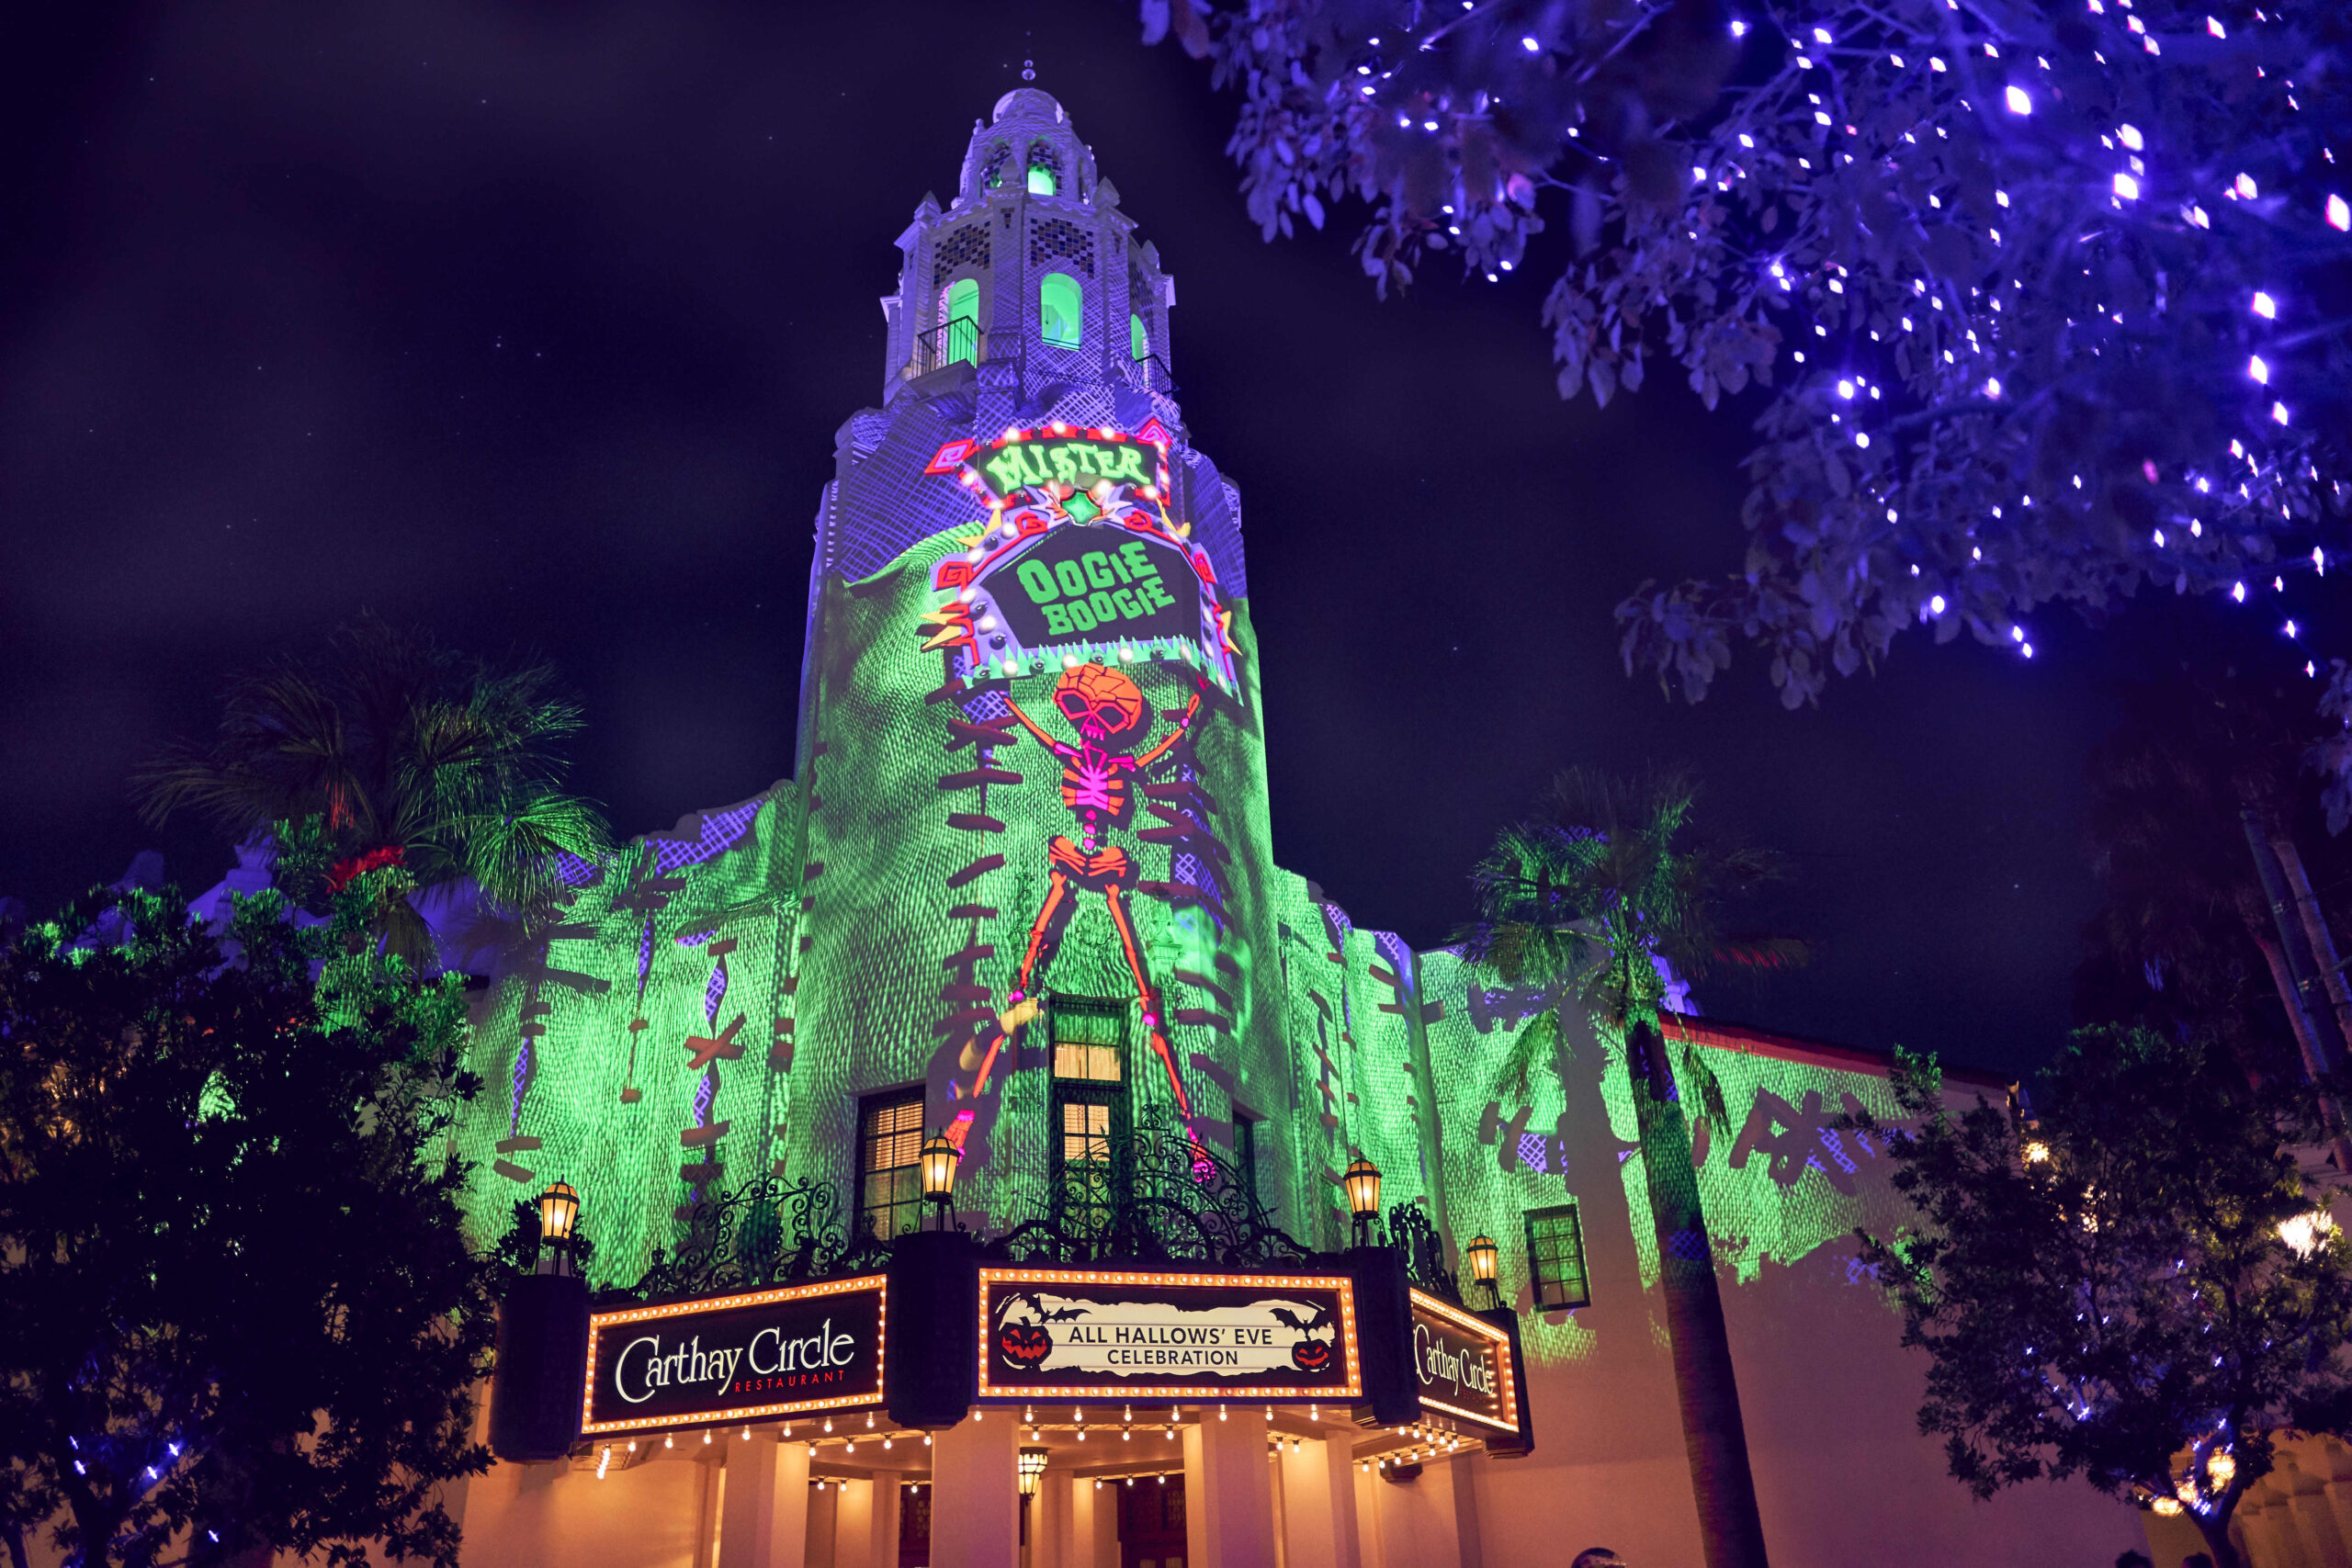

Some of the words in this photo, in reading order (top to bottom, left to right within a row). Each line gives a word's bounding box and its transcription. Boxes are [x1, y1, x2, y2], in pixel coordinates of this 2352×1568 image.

[987, 444, 1150, 493] MISTER
[1016, 541, 1158, 604] OOGIE
[1040, 576, 1176, 636] BOOGIE
[616, 1335, 743, 1404] Carthay
[749, 1318, 854, 1374] Circle
[1069, 1326, 1108, 1344] ALL
[1115, 1327, 1226, 1345] HALLOWS'
[1234, 1328, 1272, 1345] EVE
[1107, 1348, 1238, 1366] CELEBRATION
[1414, 1324, 1459, 1396] Carthay
[1460, 1348, 1493, 1394] Circle
[735, 1370, 844, 1393] RESTAURANT
